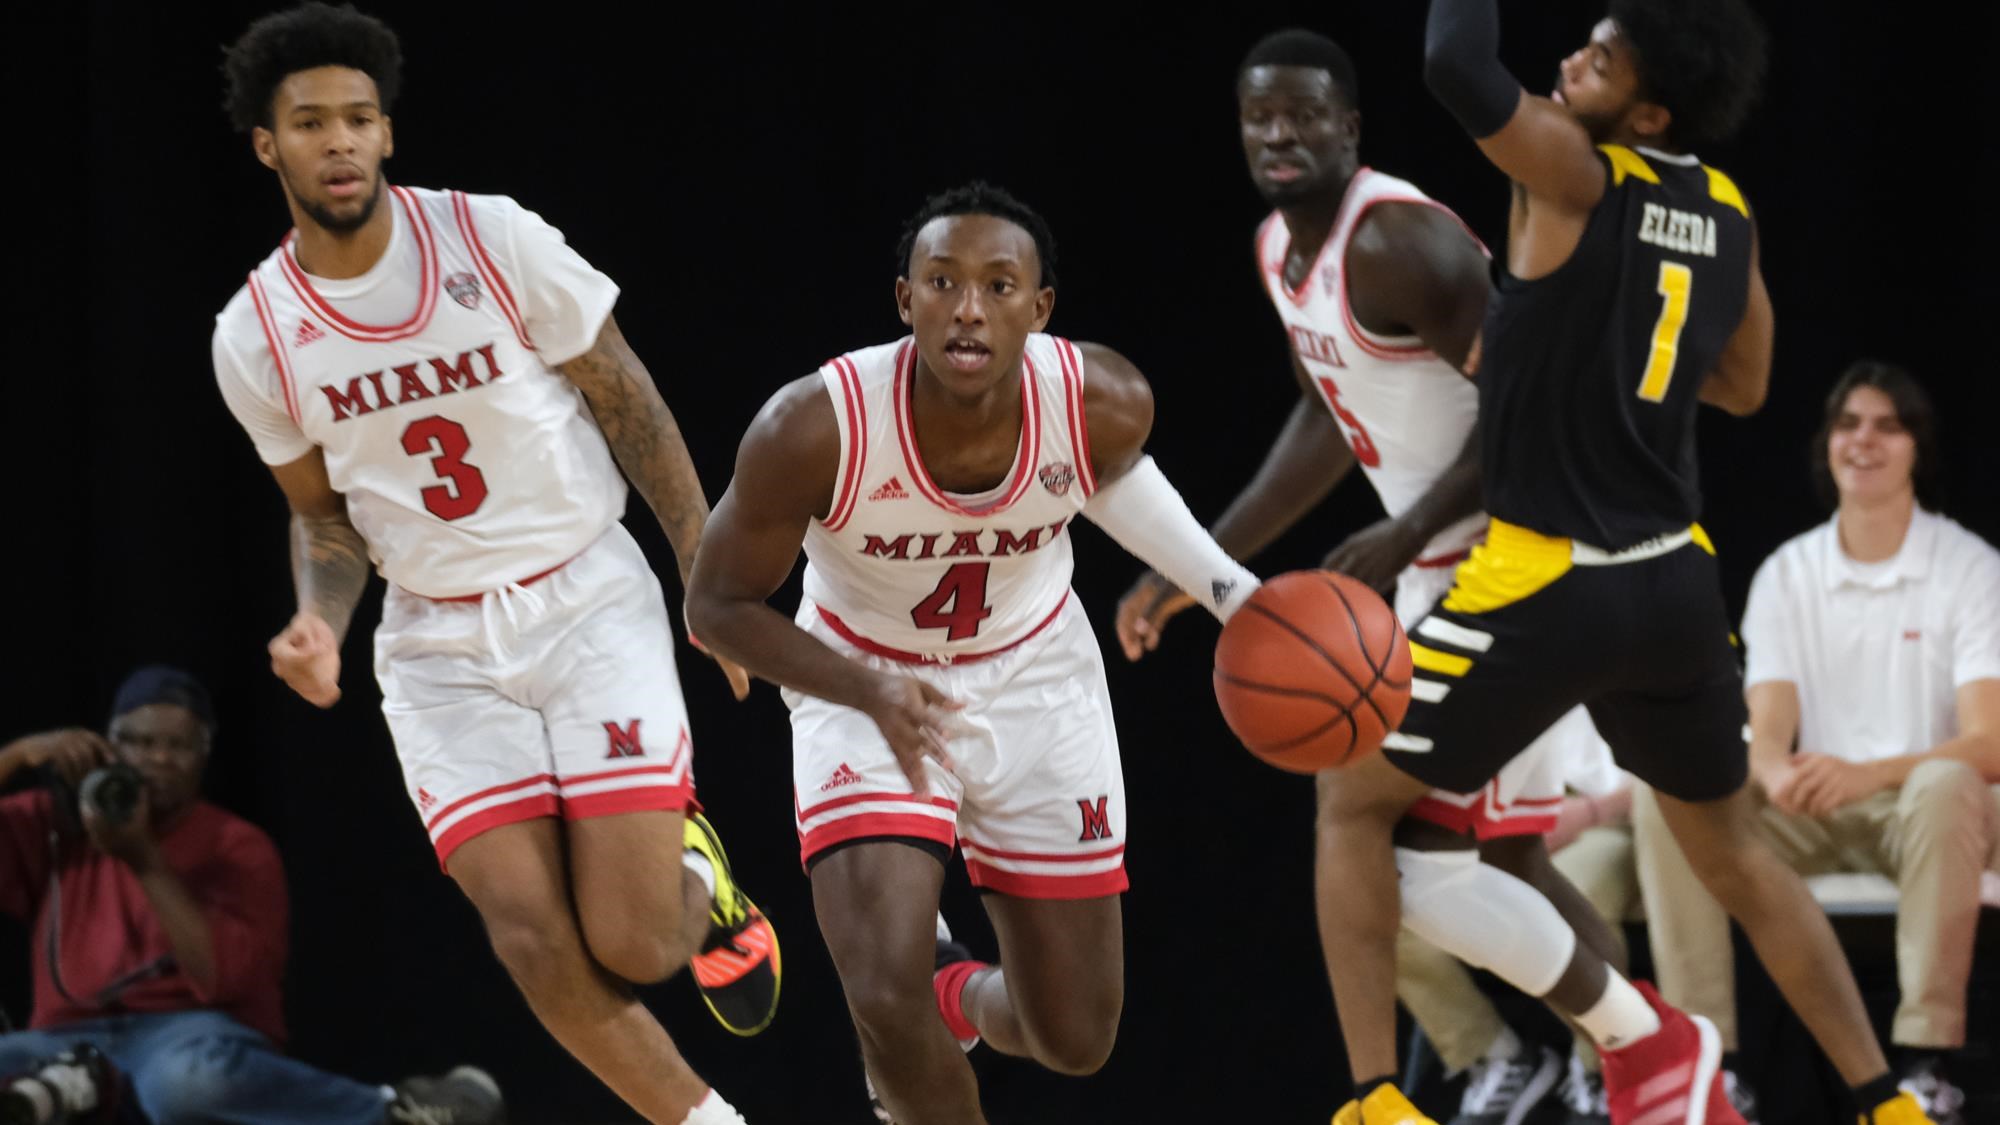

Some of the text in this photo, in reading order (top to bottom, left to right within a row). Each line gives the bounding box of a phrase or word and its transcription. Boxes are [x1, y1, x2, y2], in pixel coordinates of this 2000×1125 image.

[1636, 260, 1692, 403] 1
[319, 342, 504, 422] MIAMI
[1318, 376, 1381, 469] 5
[400, 414, 488, 522] 3
[858, 516, 1068, 560] MIAMI
[910, 561, 992, 642] 4
[601, 718, 645, 759] M
[820, 775, 862, 792] adidas
[1076, 795, 1113, 843] M
